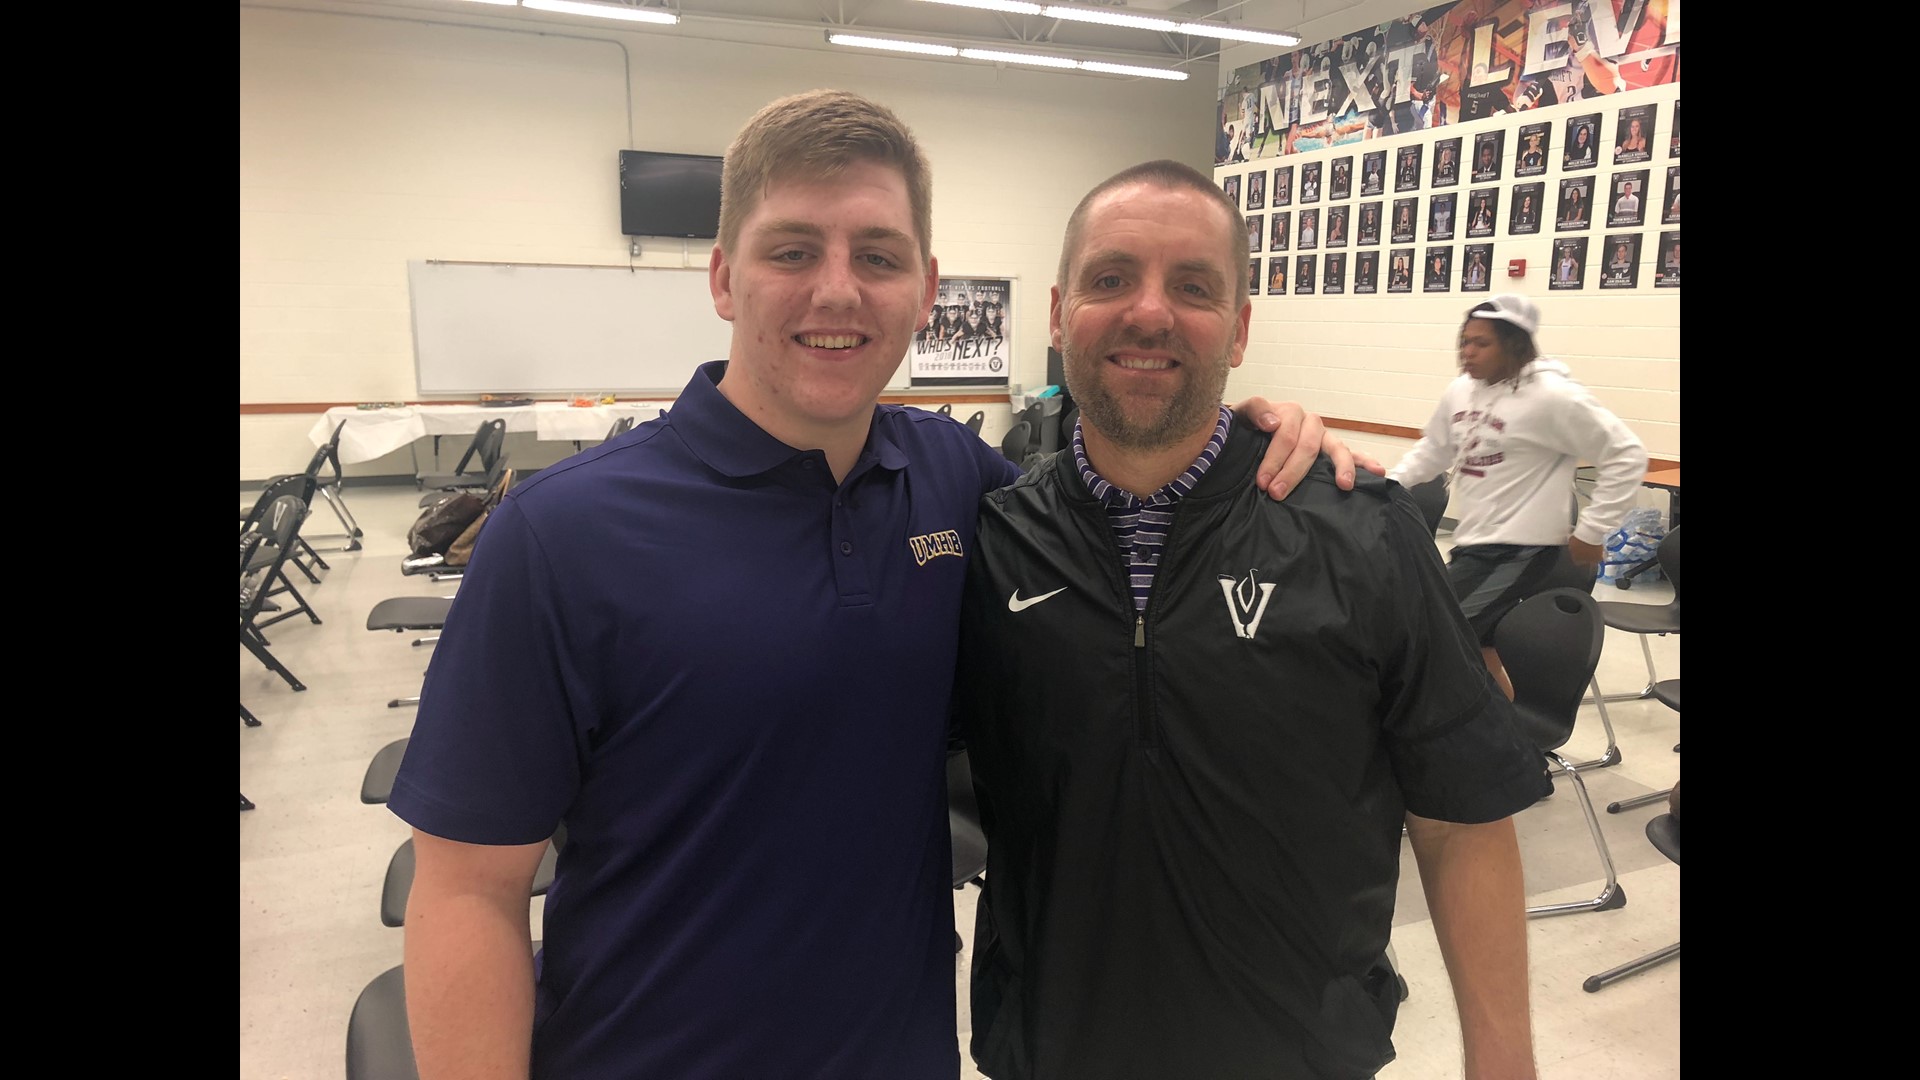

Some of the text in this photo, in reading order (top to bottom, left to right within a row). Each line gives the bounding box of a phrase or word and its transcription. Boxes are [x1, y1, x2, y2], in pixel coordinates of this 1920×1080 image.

[1258, 43, 1427, 134] NEXT
[917, 335, 1004, 361] WHO'S NEXT?
[909, 529, 964, 567] UMHB
